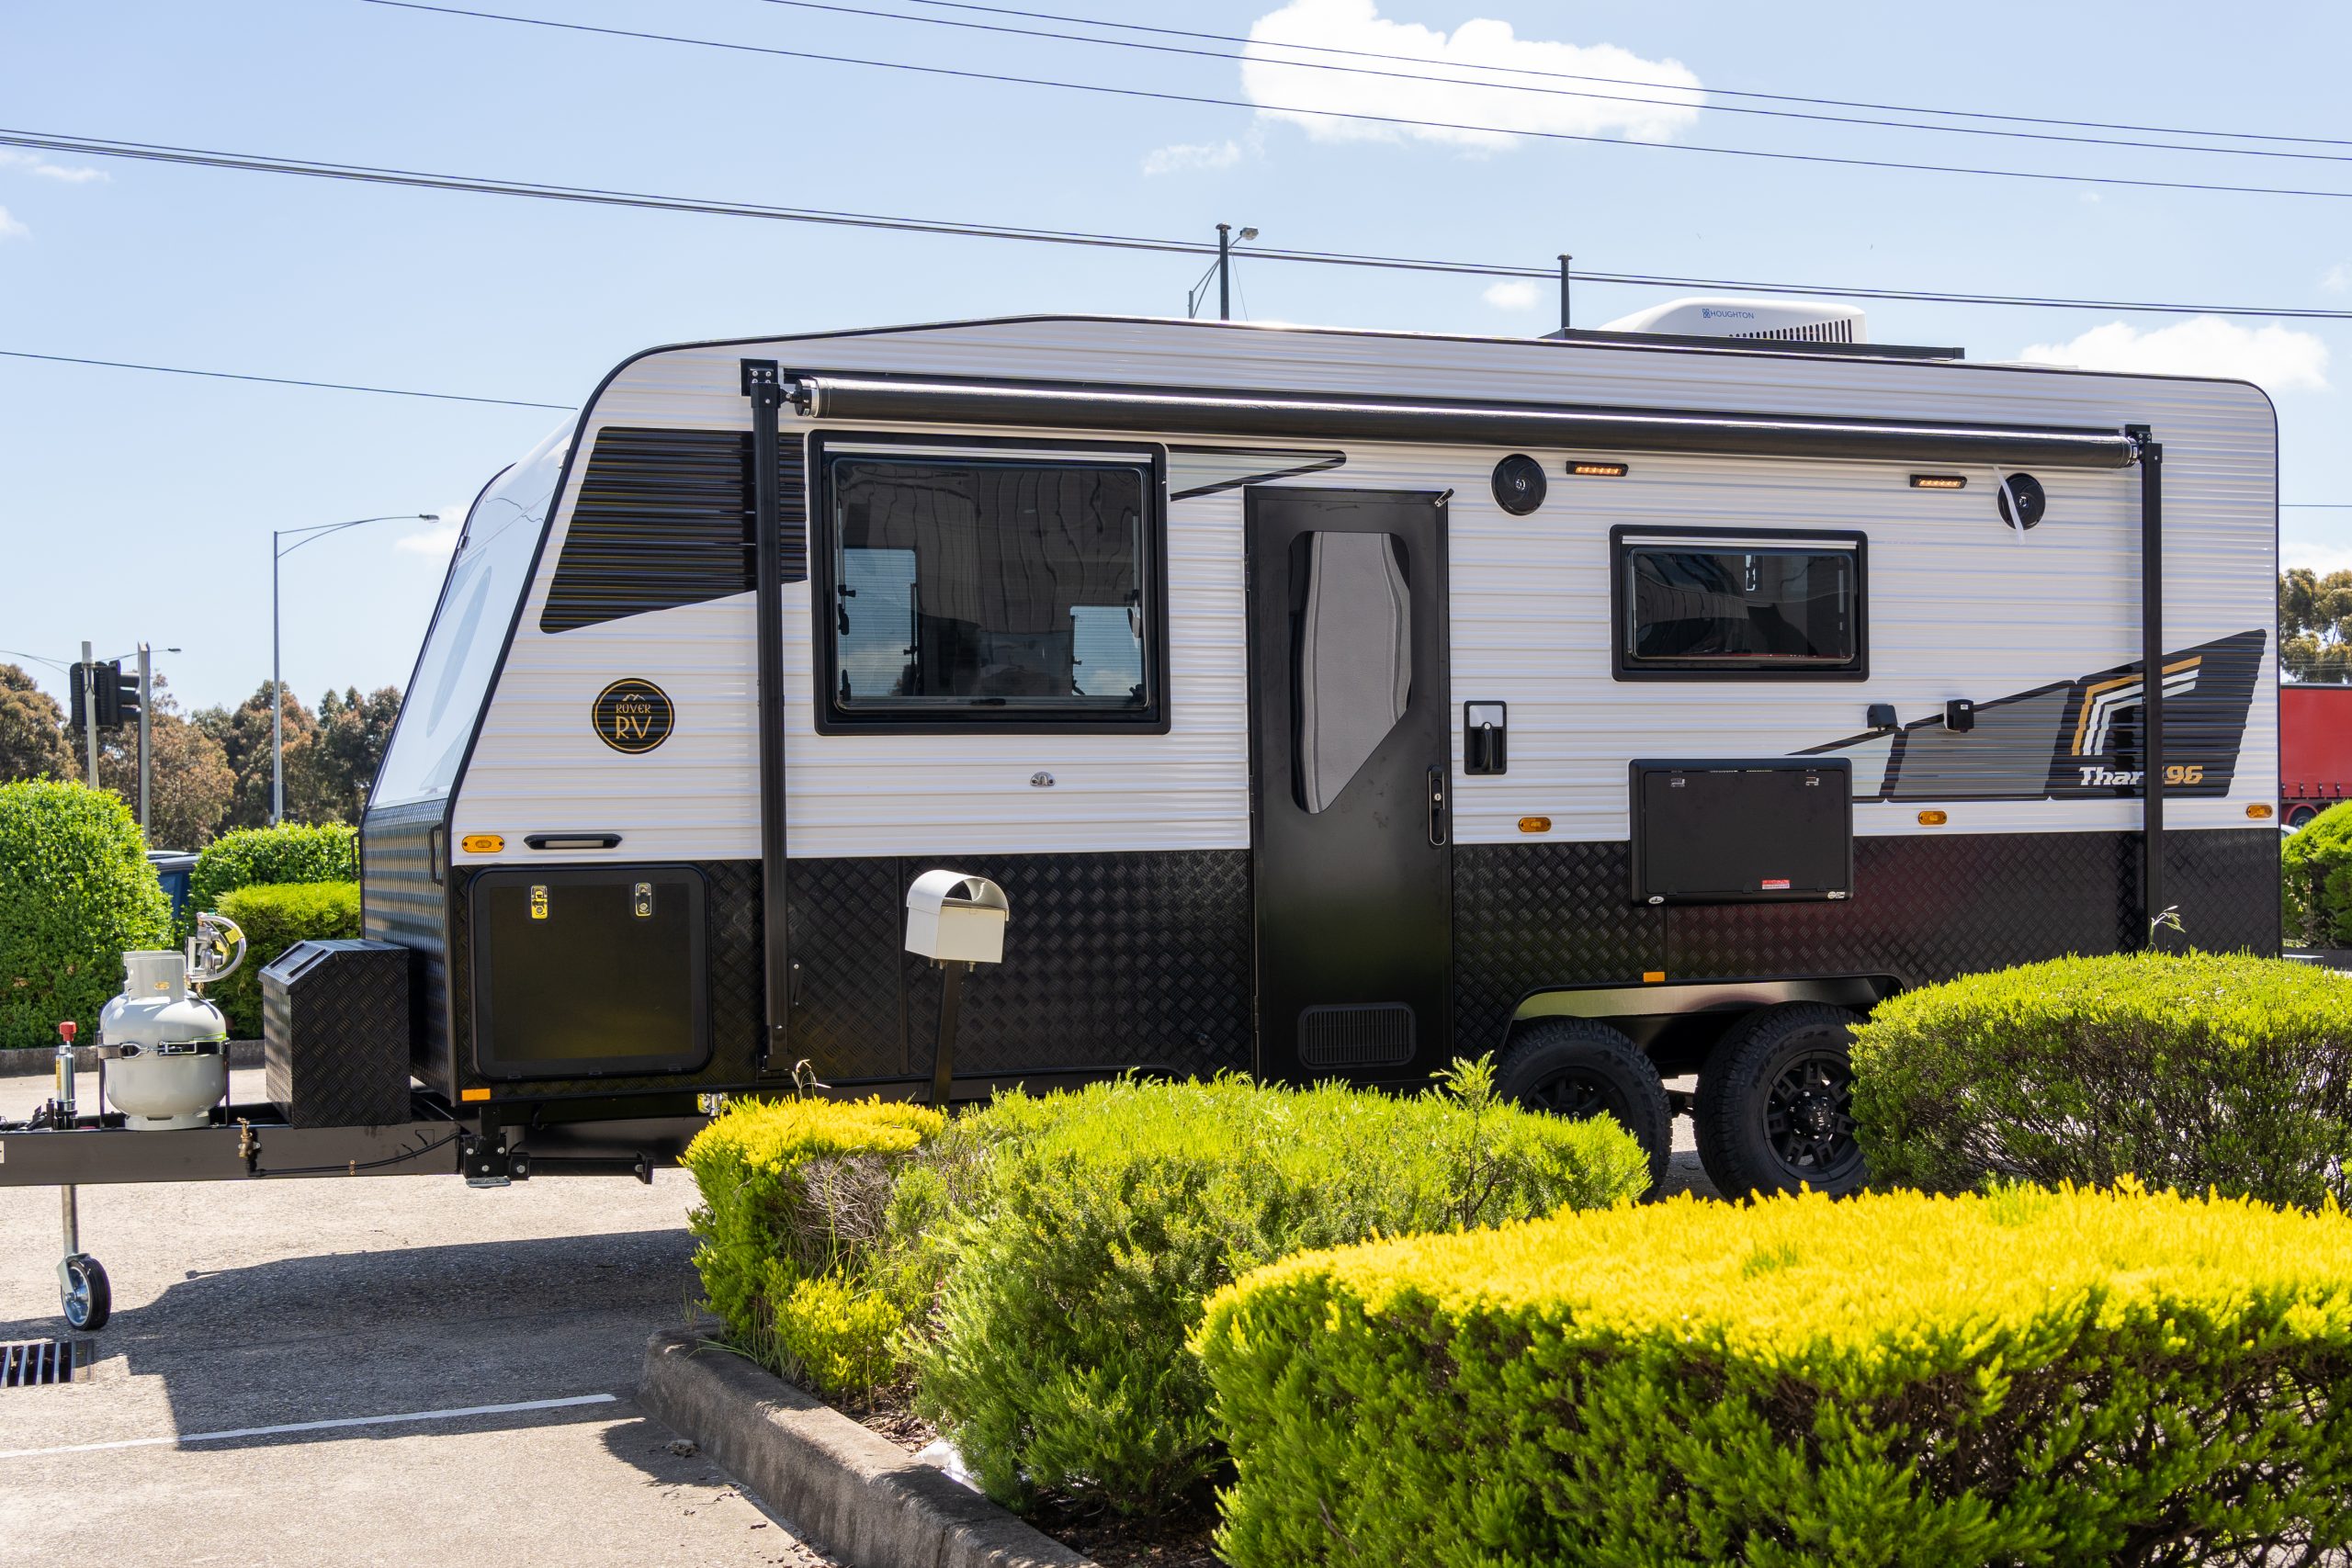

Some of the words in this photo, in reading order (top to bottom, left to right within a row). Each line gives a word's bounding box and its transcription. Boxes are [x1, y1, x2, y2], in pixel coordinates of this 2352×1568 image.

[1710, 310, 1755, 319] HOUGHTON
[615, 704, 651, 714] ROVER
[615, 715, 652, 739] RV
[2078, 766, 2144, 786] Thar
[2162, 765, 2204, 785] 96
